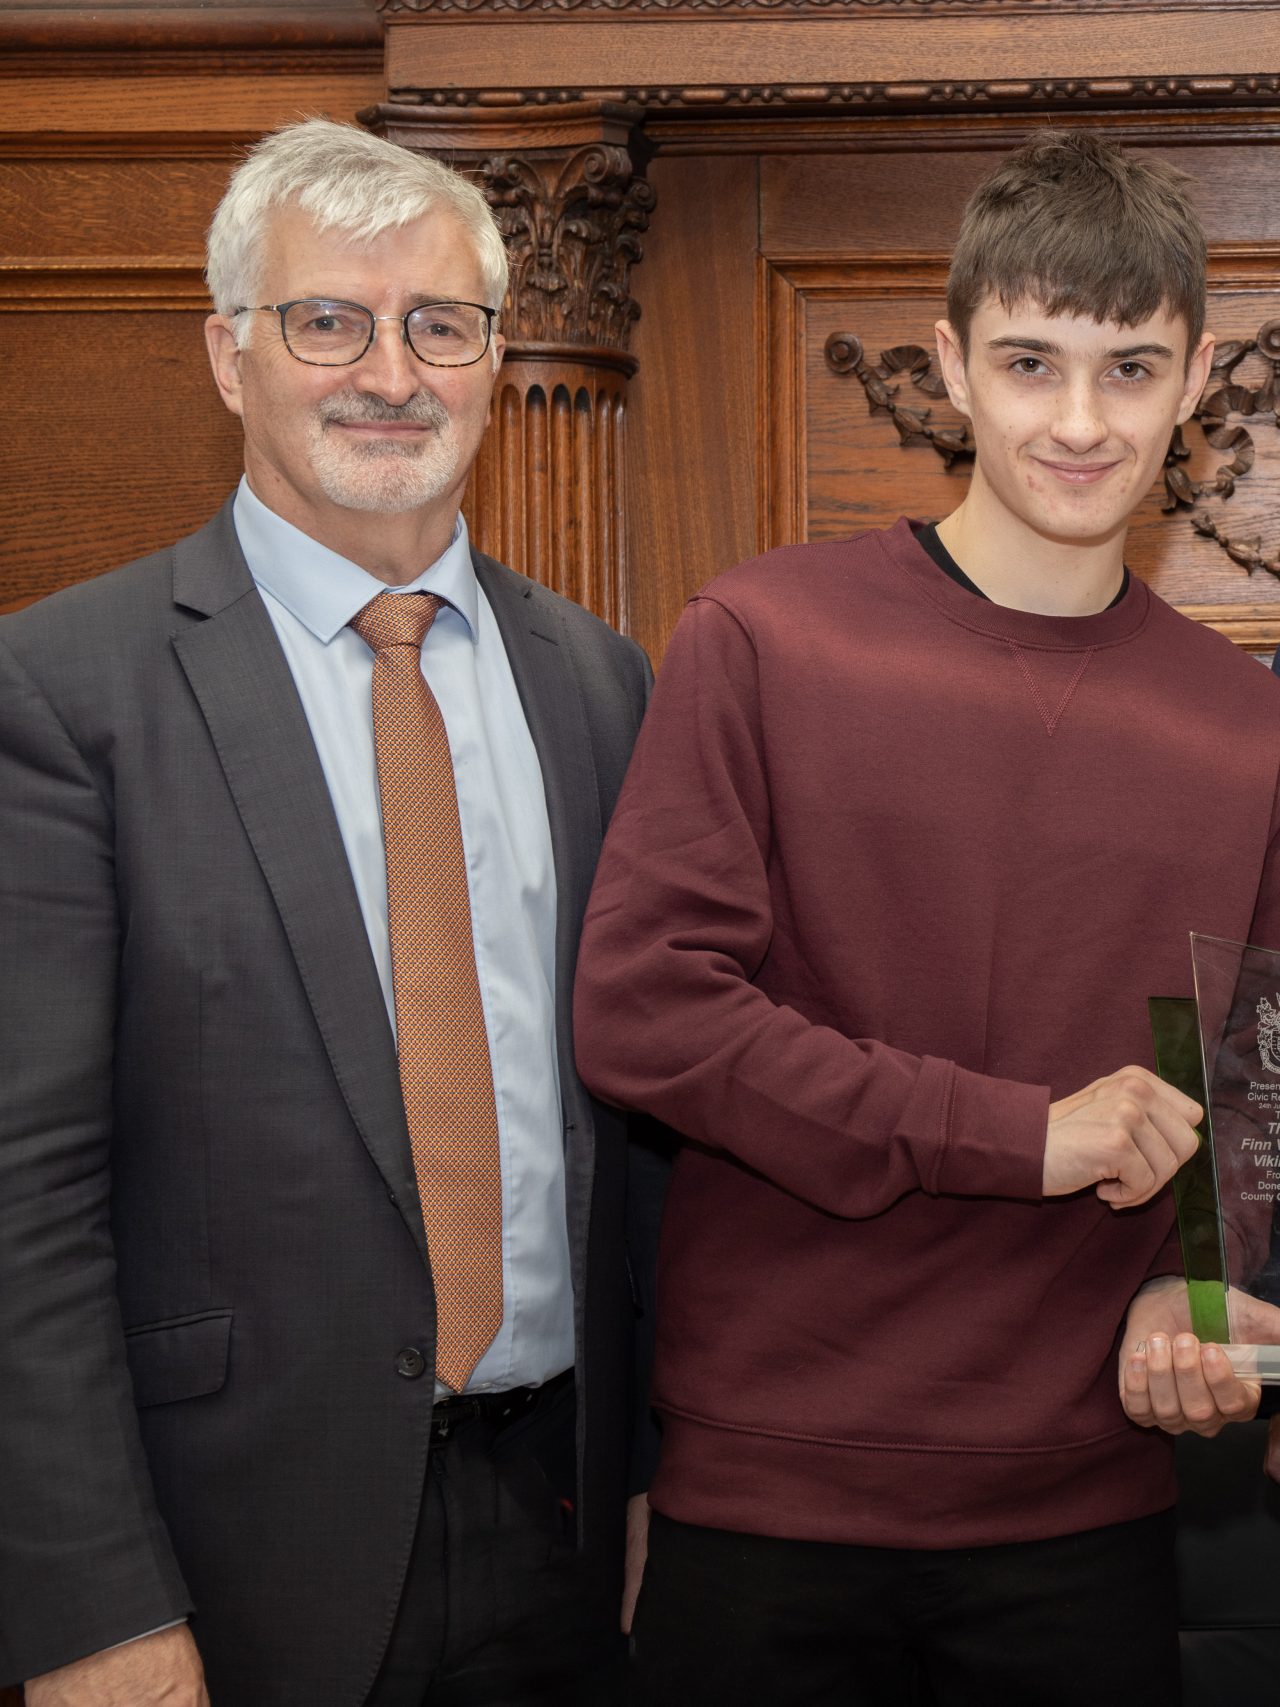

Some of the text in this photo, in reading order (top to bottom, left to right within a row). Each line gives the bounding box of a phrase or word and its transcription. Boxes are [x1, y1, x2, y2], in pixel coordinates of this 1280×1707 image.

[1248, 1092, 1268, 1101] Civic
[1241, 1138, 1271, 1150] Finn
[1241, 1192, 1274, 1203] County
